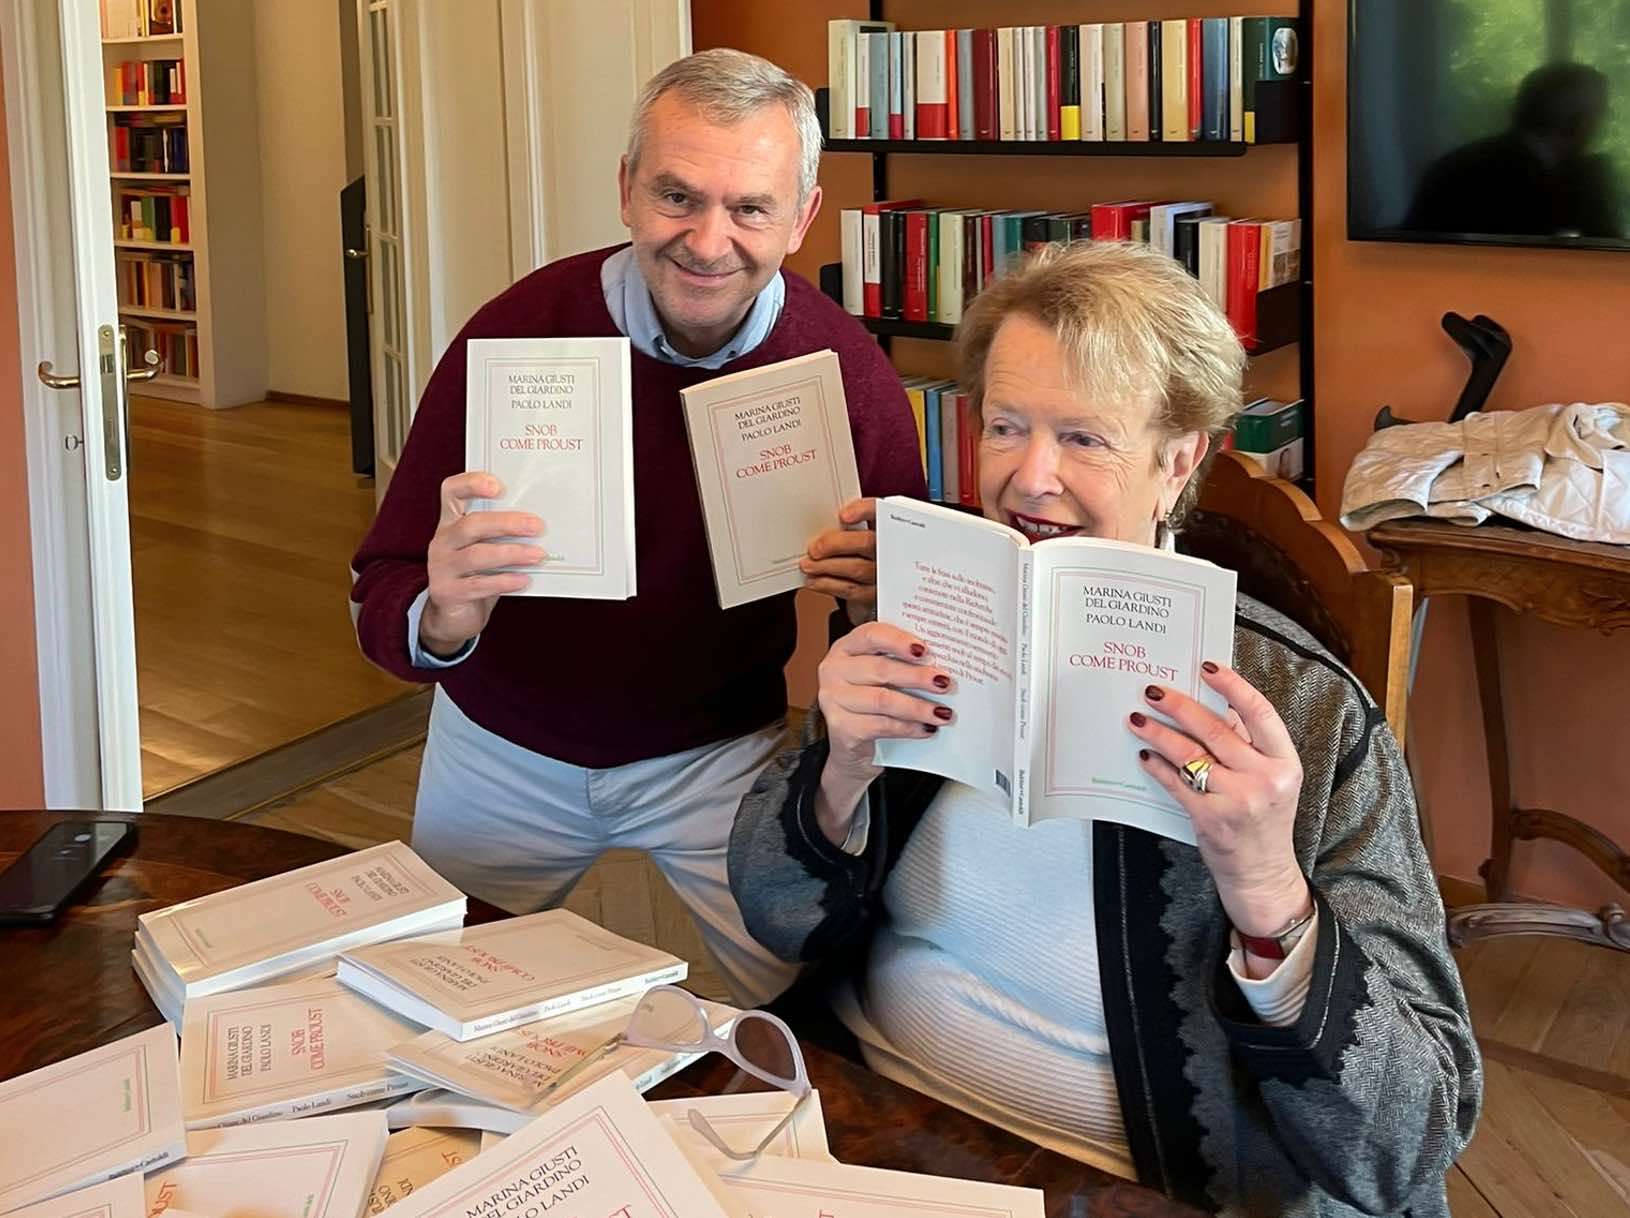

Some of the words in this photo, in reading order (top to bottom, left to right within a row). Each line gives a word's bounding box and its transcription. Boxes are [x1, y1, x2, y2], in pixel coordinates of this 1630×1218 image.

[508, 374, 544, 385] MARINA
[544, 374, 575, 385] GIUSTI
[510, 385, 526, 395] DEL
[527, 385, 574, 395] GIARDINO
[511, 399, 541, 409] PAOLO
[542, 399, 572, 409] LANDI
[735, 404, 771, 421] MARINA
[772, 396, 802, 412] GIUSTI
[738, 417, 755, 430] DEL
[755, 406, 801, 426] GIARDINO
[525, 424, 557, 436] SNOB
[742, 426, 772, 442] PAOLO
[773, 418, 802, 435] LANDI
[500, 438, 535, 450] COME
[536, 438, 584, 450] PROUST
[759, 444, 792, 461] SNOB
[736, 462, 773, 480] COME
[773, 449, 818, 472] PROUST
[1083, 585, 1132, 601] MARINA
[1133, 591, 1172, 608] GIUSTI
[1085, 598, 1107, 609] DEL
[1108, 599, 1169, 618] GIARDINO
[1086, 613, 1126, 626] PAOLO
[1129, 618, 1166, 634] LANDI
[1103, 641, 1146, 659] SNOB
[1069, 653, 1116, 670] COME
[1118, 659, 1179, 681] PROUST
[291, 1027, 306, 1057] SNOB
[466, 1178, 529, 1218] MARINA
[529, 1145, 578, 1182] GIUSTI
[506, 1159, 582, 1212] GIARDINO
[542, 1175, 590, 1211] LANDI
